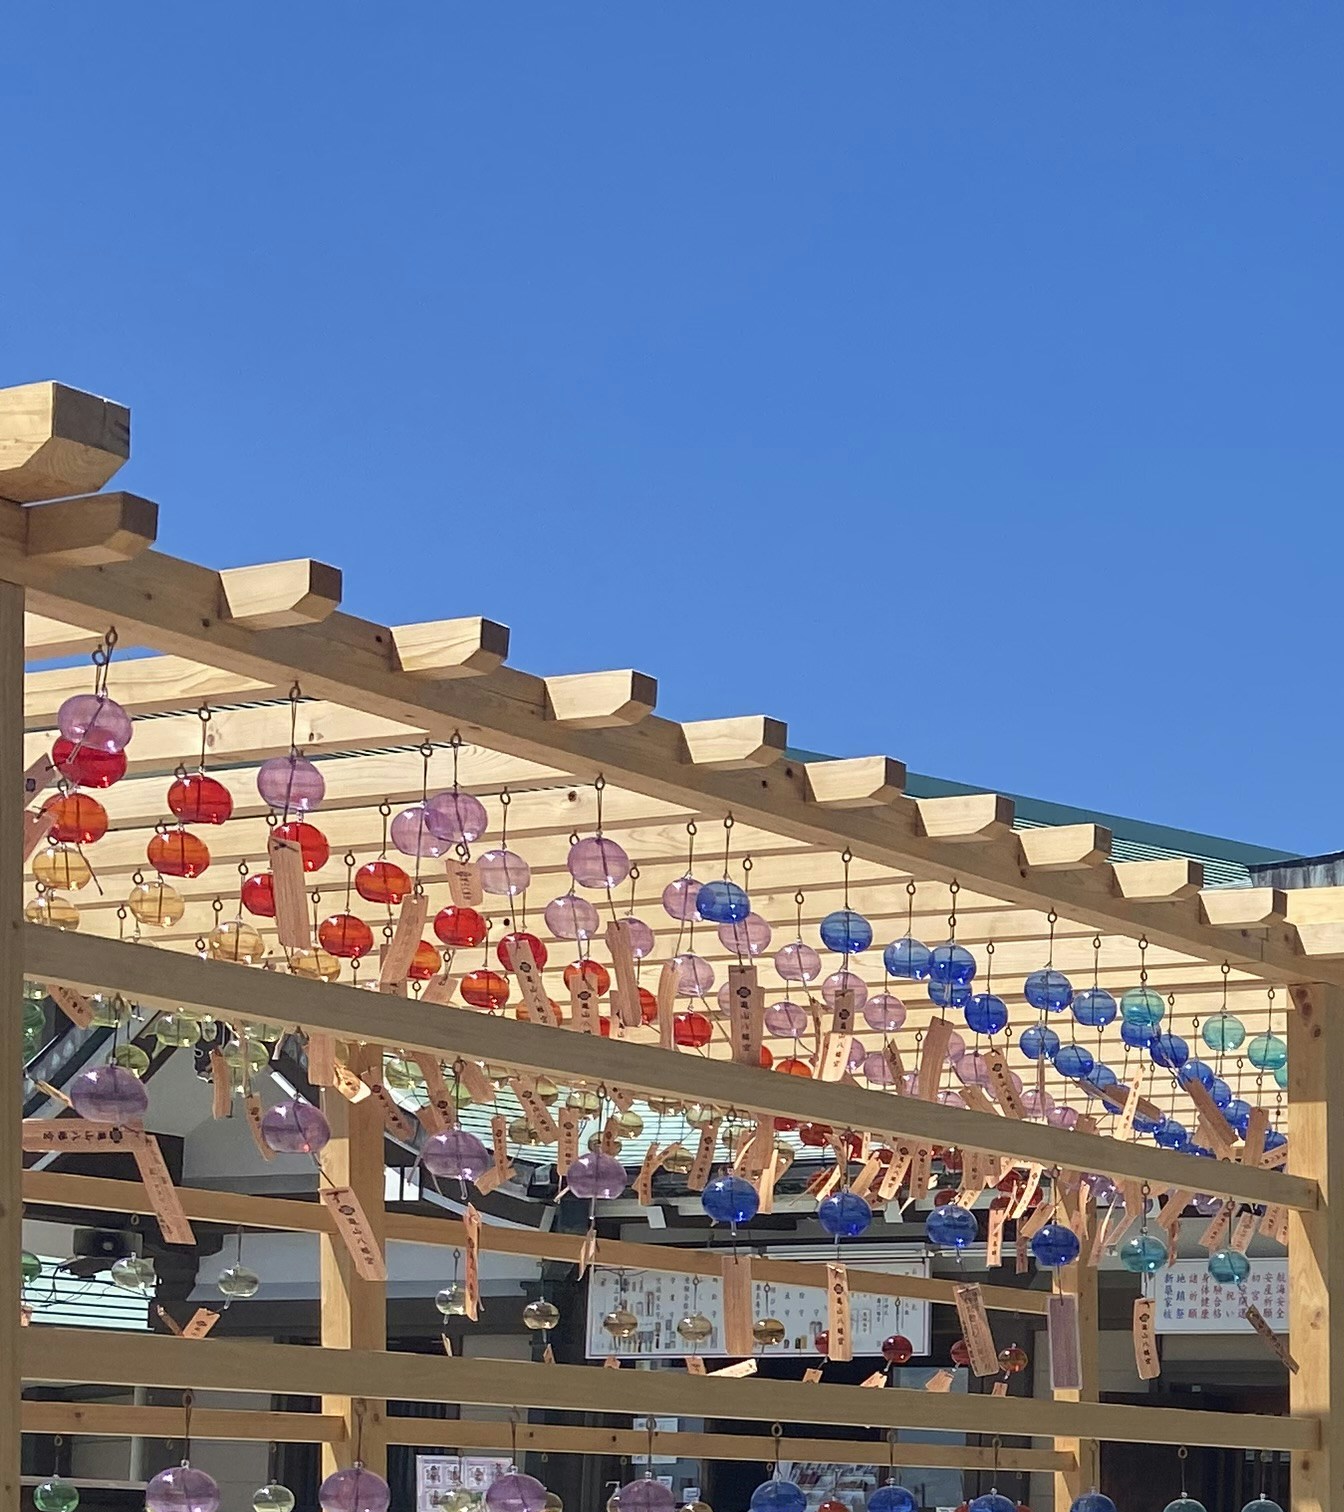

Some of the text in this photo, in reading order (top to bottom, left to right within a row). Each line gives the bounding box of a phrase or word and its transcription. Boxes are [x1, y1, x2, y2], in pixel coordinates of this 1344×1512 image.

[1263, 1271, 1273, 1319] 安産祈願
[1276, 1272, 1287, 1319] 航海安全
